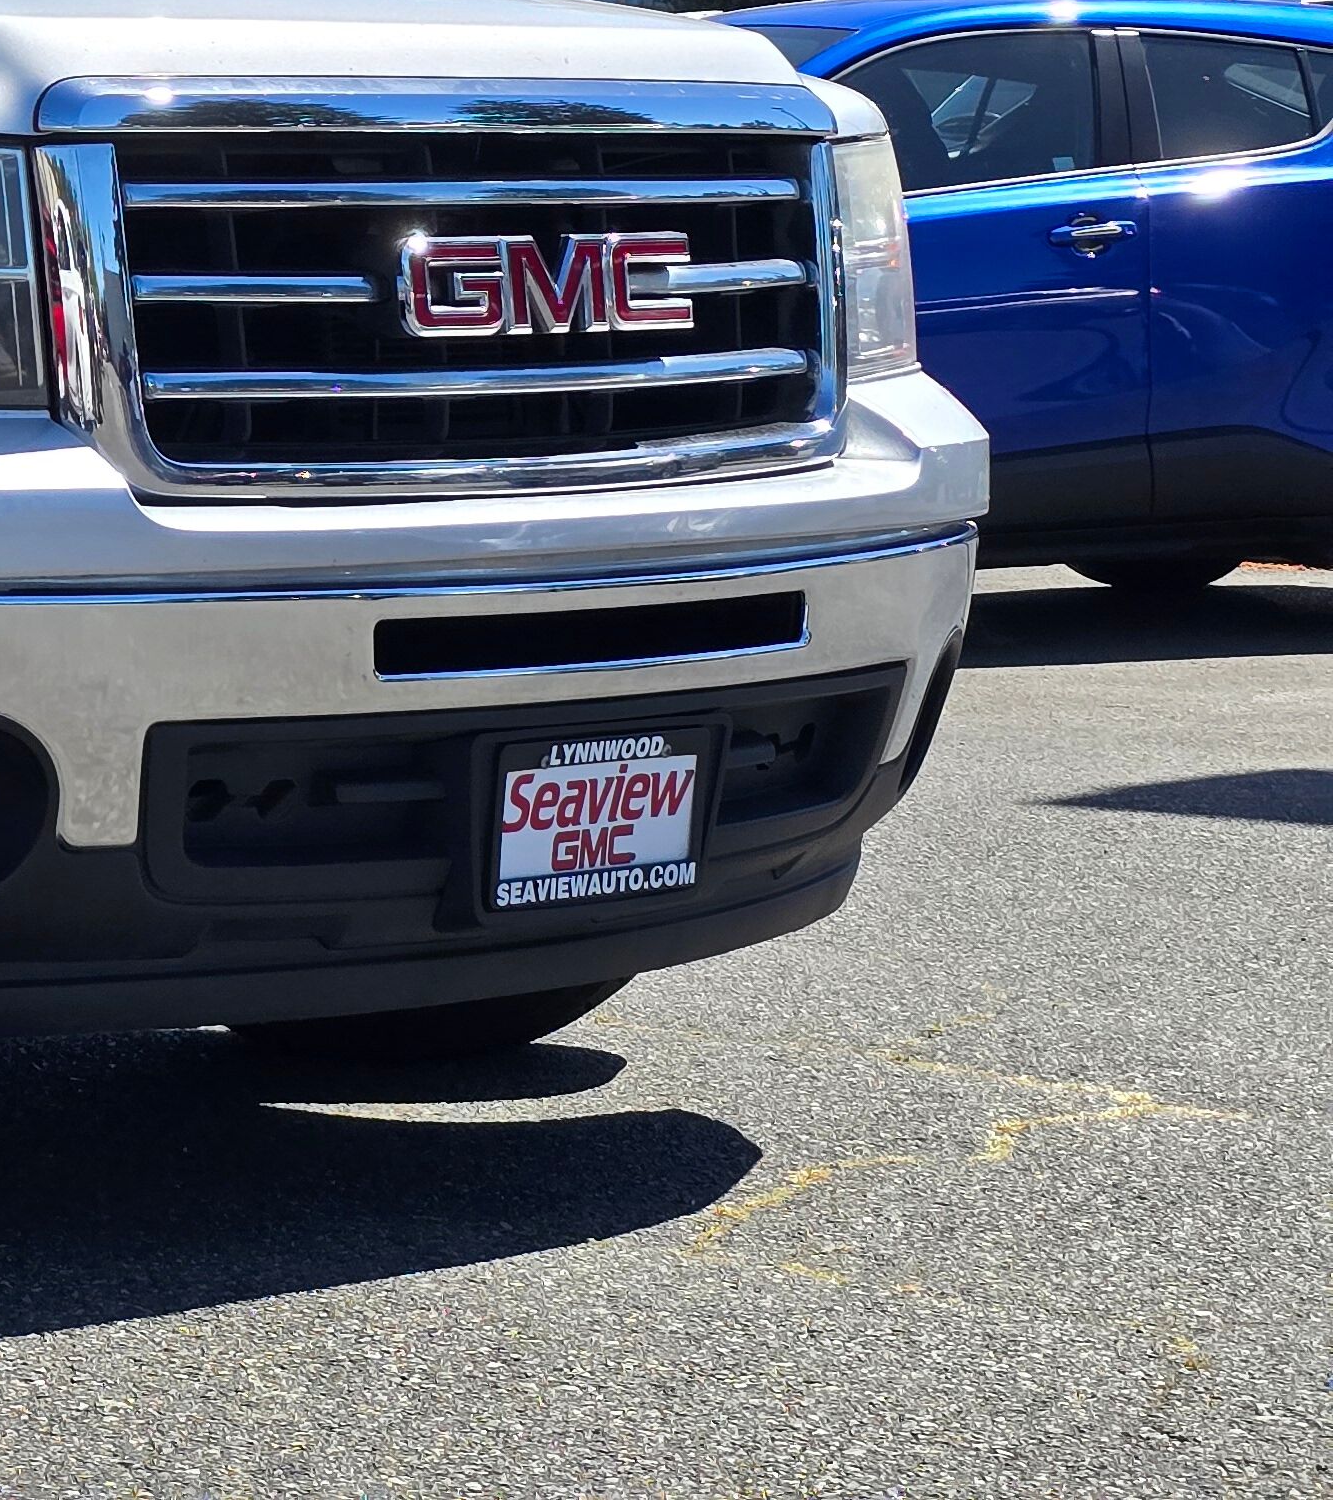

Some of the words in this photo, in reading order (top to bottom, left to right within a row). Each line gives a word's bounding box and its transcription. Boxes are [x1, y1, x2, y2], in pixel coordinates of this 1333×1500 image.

[400, 231, 695, 338] GMC
[549, 735, 665, 767] LYNNWOOD
[501, 763, 695, 834] Seaview
[550, 824, 636, 872] GMC
[496, 861, 697, 908] SEAVIEWAUTO.COM
